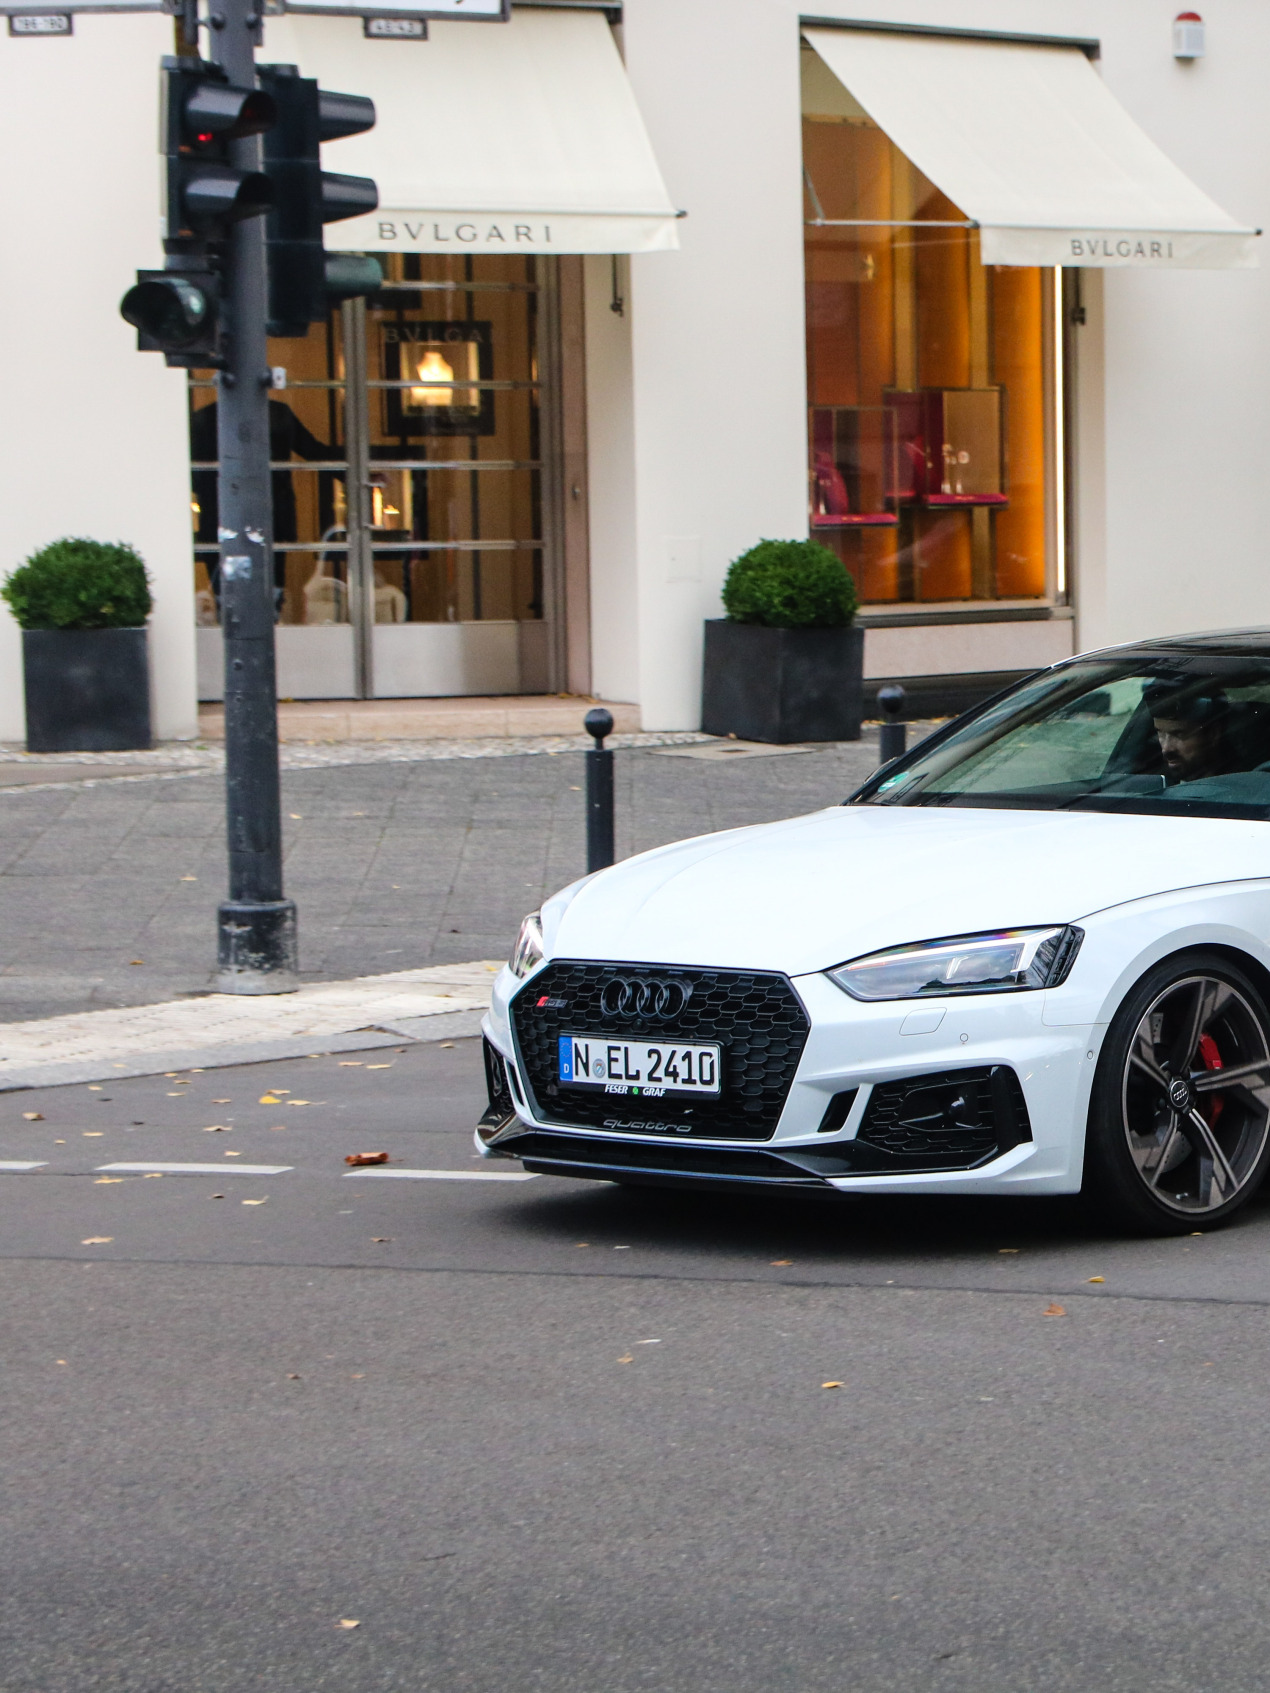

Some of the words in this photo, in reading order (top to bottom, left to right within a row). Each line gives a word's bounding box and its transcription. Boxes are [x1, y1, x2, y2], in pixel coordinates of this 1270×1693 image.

[378, 222, 552, 243] BVLGARI
[1070, 239, 1173, 258] BVLGARI
[563, 1063, 570, 1074] D
[574, 1042, 589, 1077] N
[607, 1045, 640, 1081] EL
[647, 1048, 715, 1086] 2410
[605, 1084, 628, 1095] FESER
[642, 1088, 666, 1097] GRAF
[603, 1119, 692, 1133] quattro
